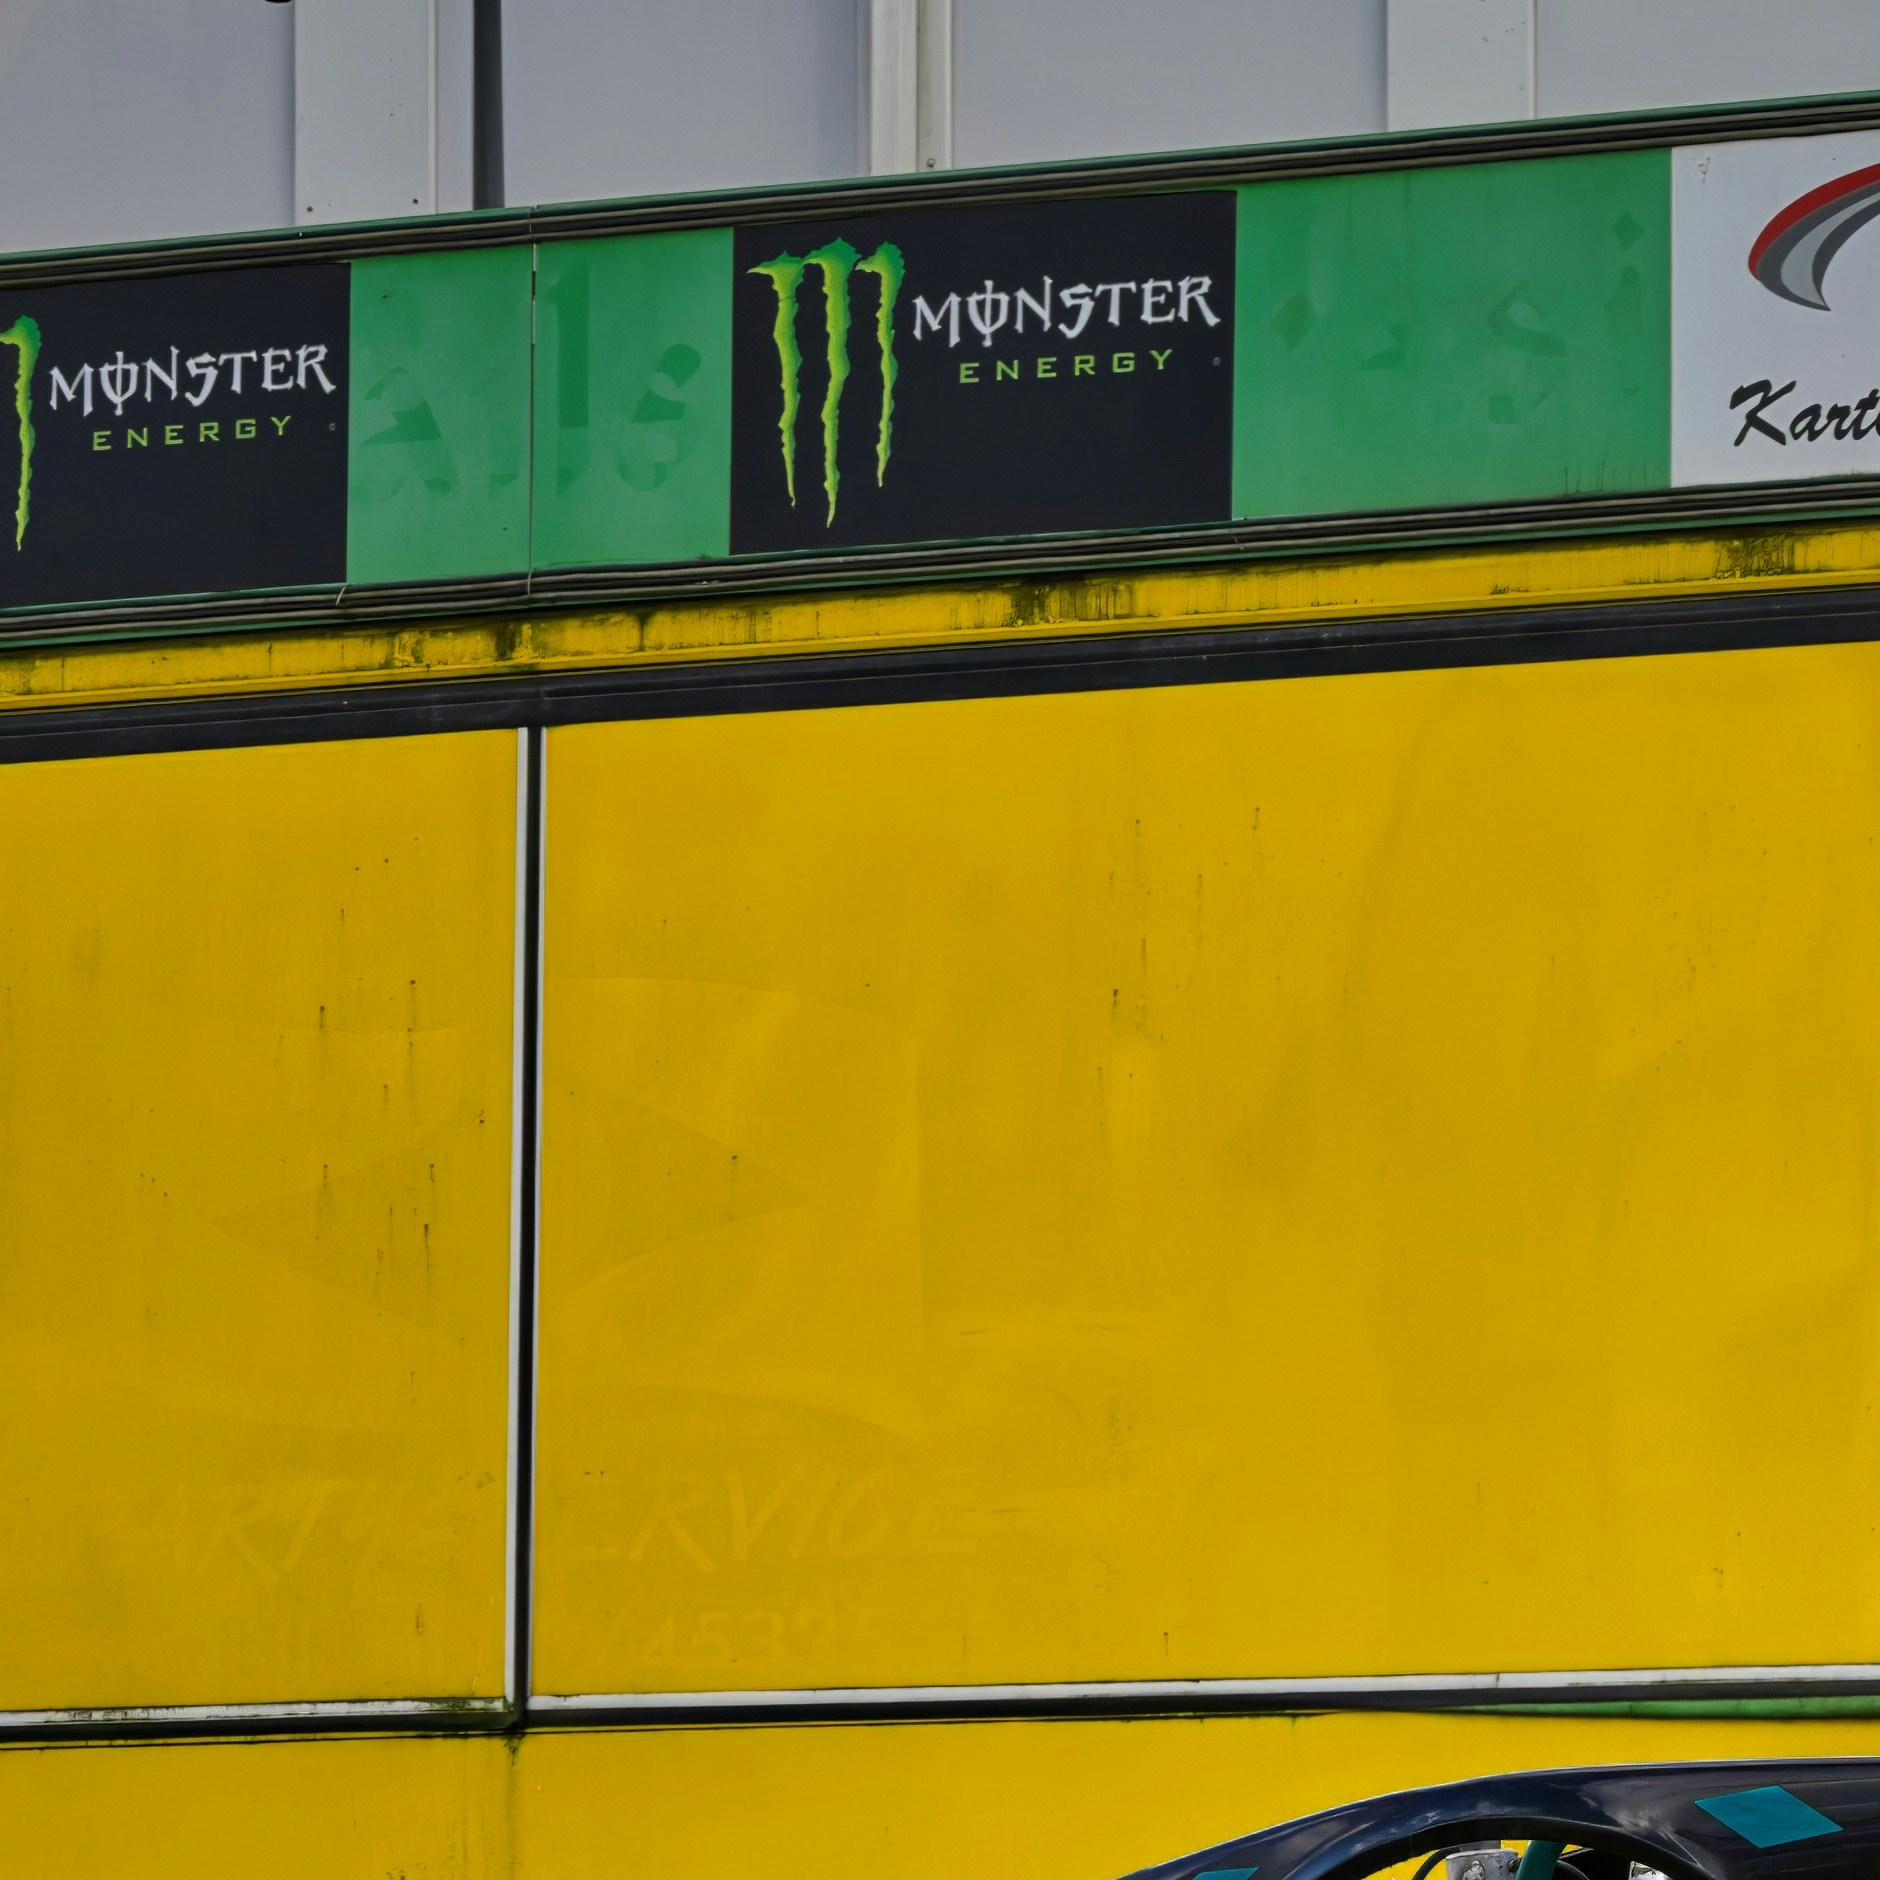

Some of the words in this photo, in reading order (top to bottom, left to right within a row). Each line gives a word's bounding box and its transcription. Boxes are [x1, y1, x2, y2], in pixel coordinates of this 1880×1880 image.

[912, 274, 1221, 348] MONSTER
[48, 343, 337, 417] MONSTER
[958, 347, 1173, 385] ENERGY
[92, 414, 292, 452] ENERGY
